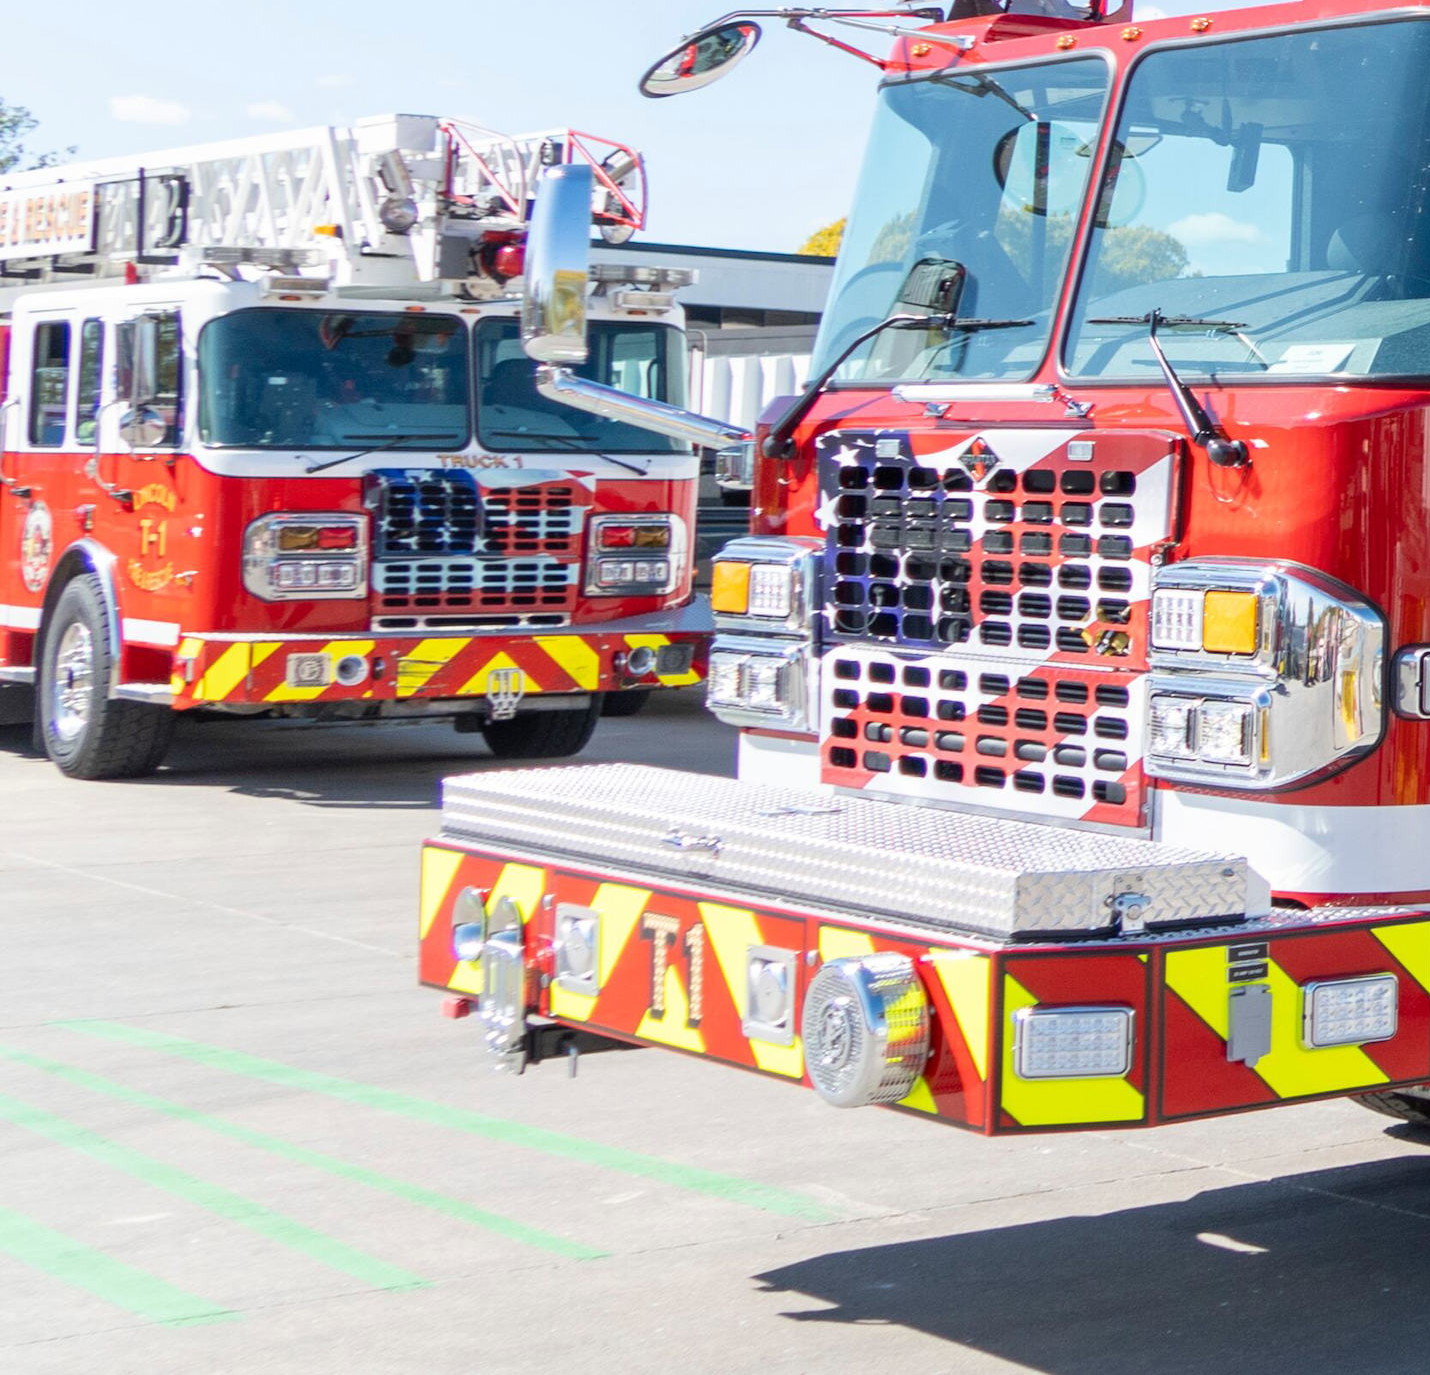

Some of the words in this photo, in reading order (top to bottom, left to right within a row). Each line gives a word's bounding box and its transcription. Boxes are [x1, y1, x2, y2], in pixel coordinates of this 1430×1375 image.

[436, 454, 509, 468] TRUCK
[513, 455, 524, 468] 1
[139, 519, 168, 558] T-1
[639, 911, 704, 1028] T1
